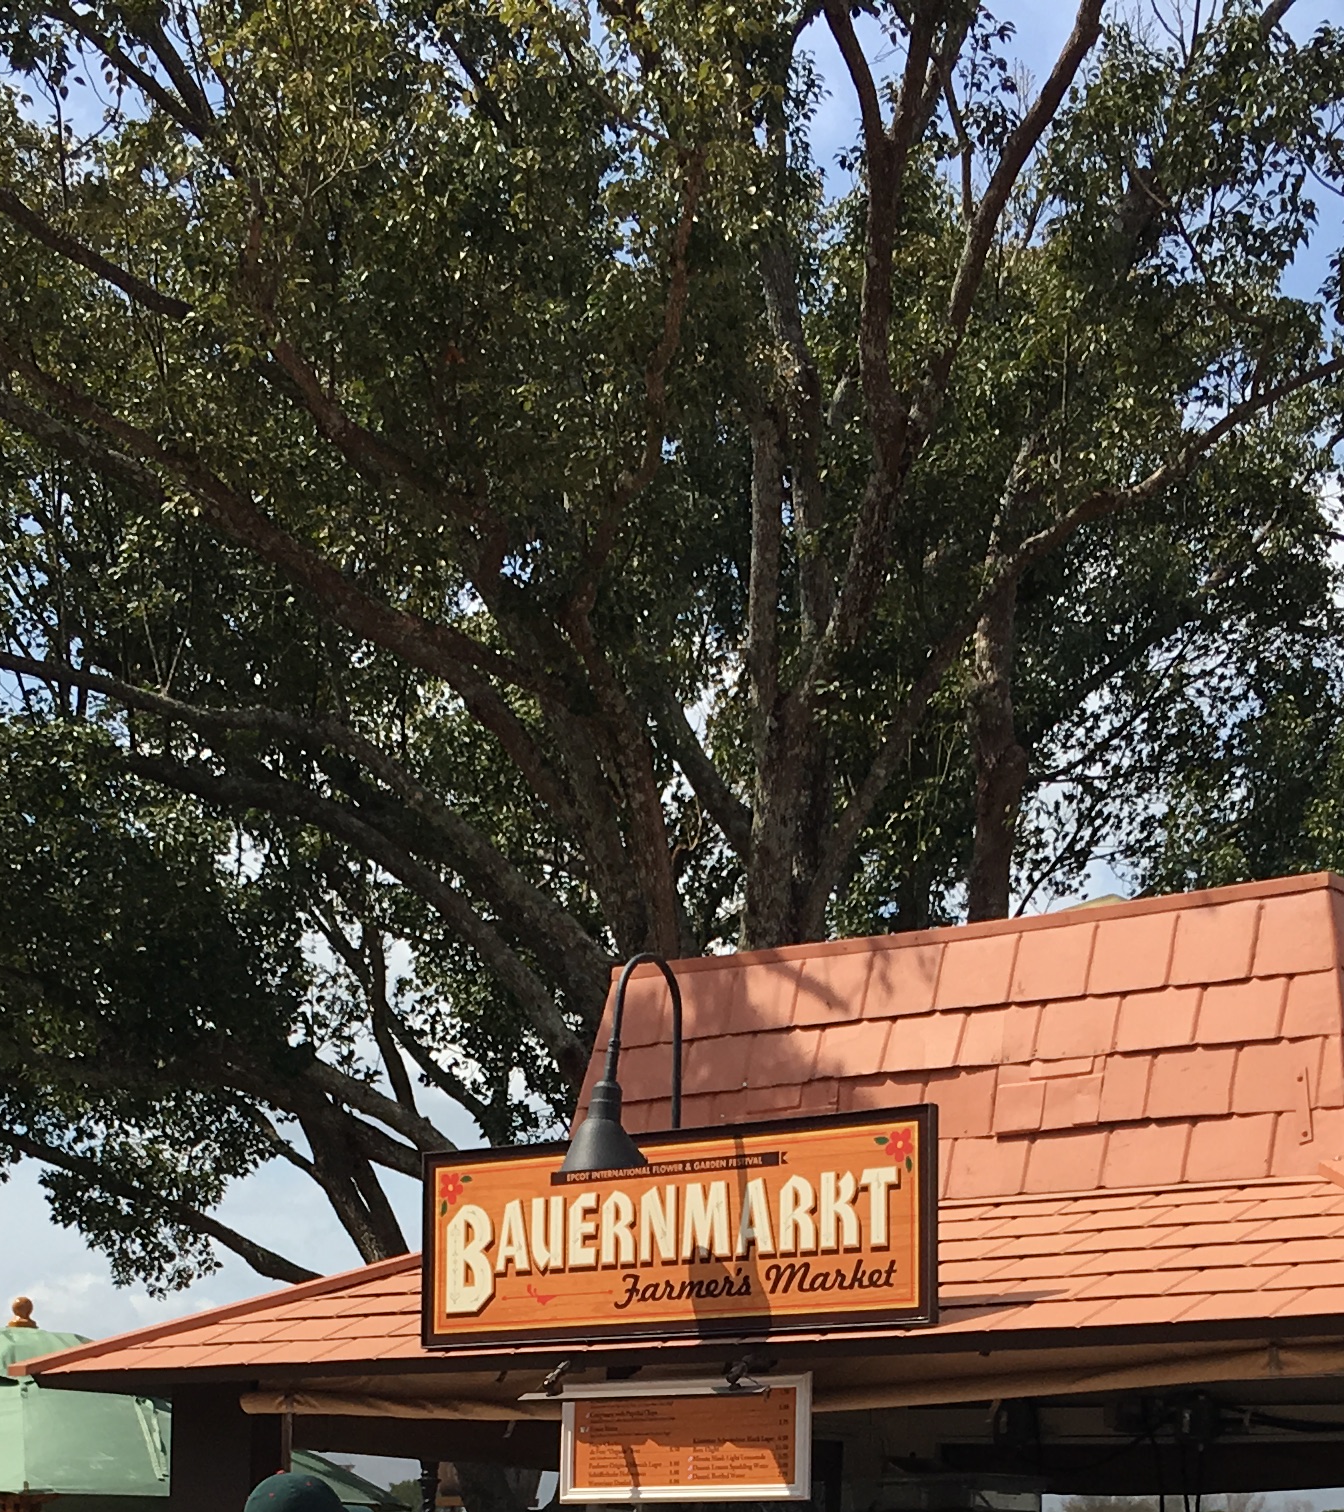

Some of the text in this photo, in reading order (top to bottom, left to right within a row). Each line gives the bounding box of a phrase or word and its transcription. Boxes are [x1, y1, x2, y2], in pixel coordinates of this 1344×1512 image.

[566, 1156, 763, 1182] EPCOT INTERNATIONAL FLOWER & GARDEN FESTIVAL
[445, 1166, 901, 1316] BAUERNMARKT
[614, 1258, 899, 1309] Farmer's Market
